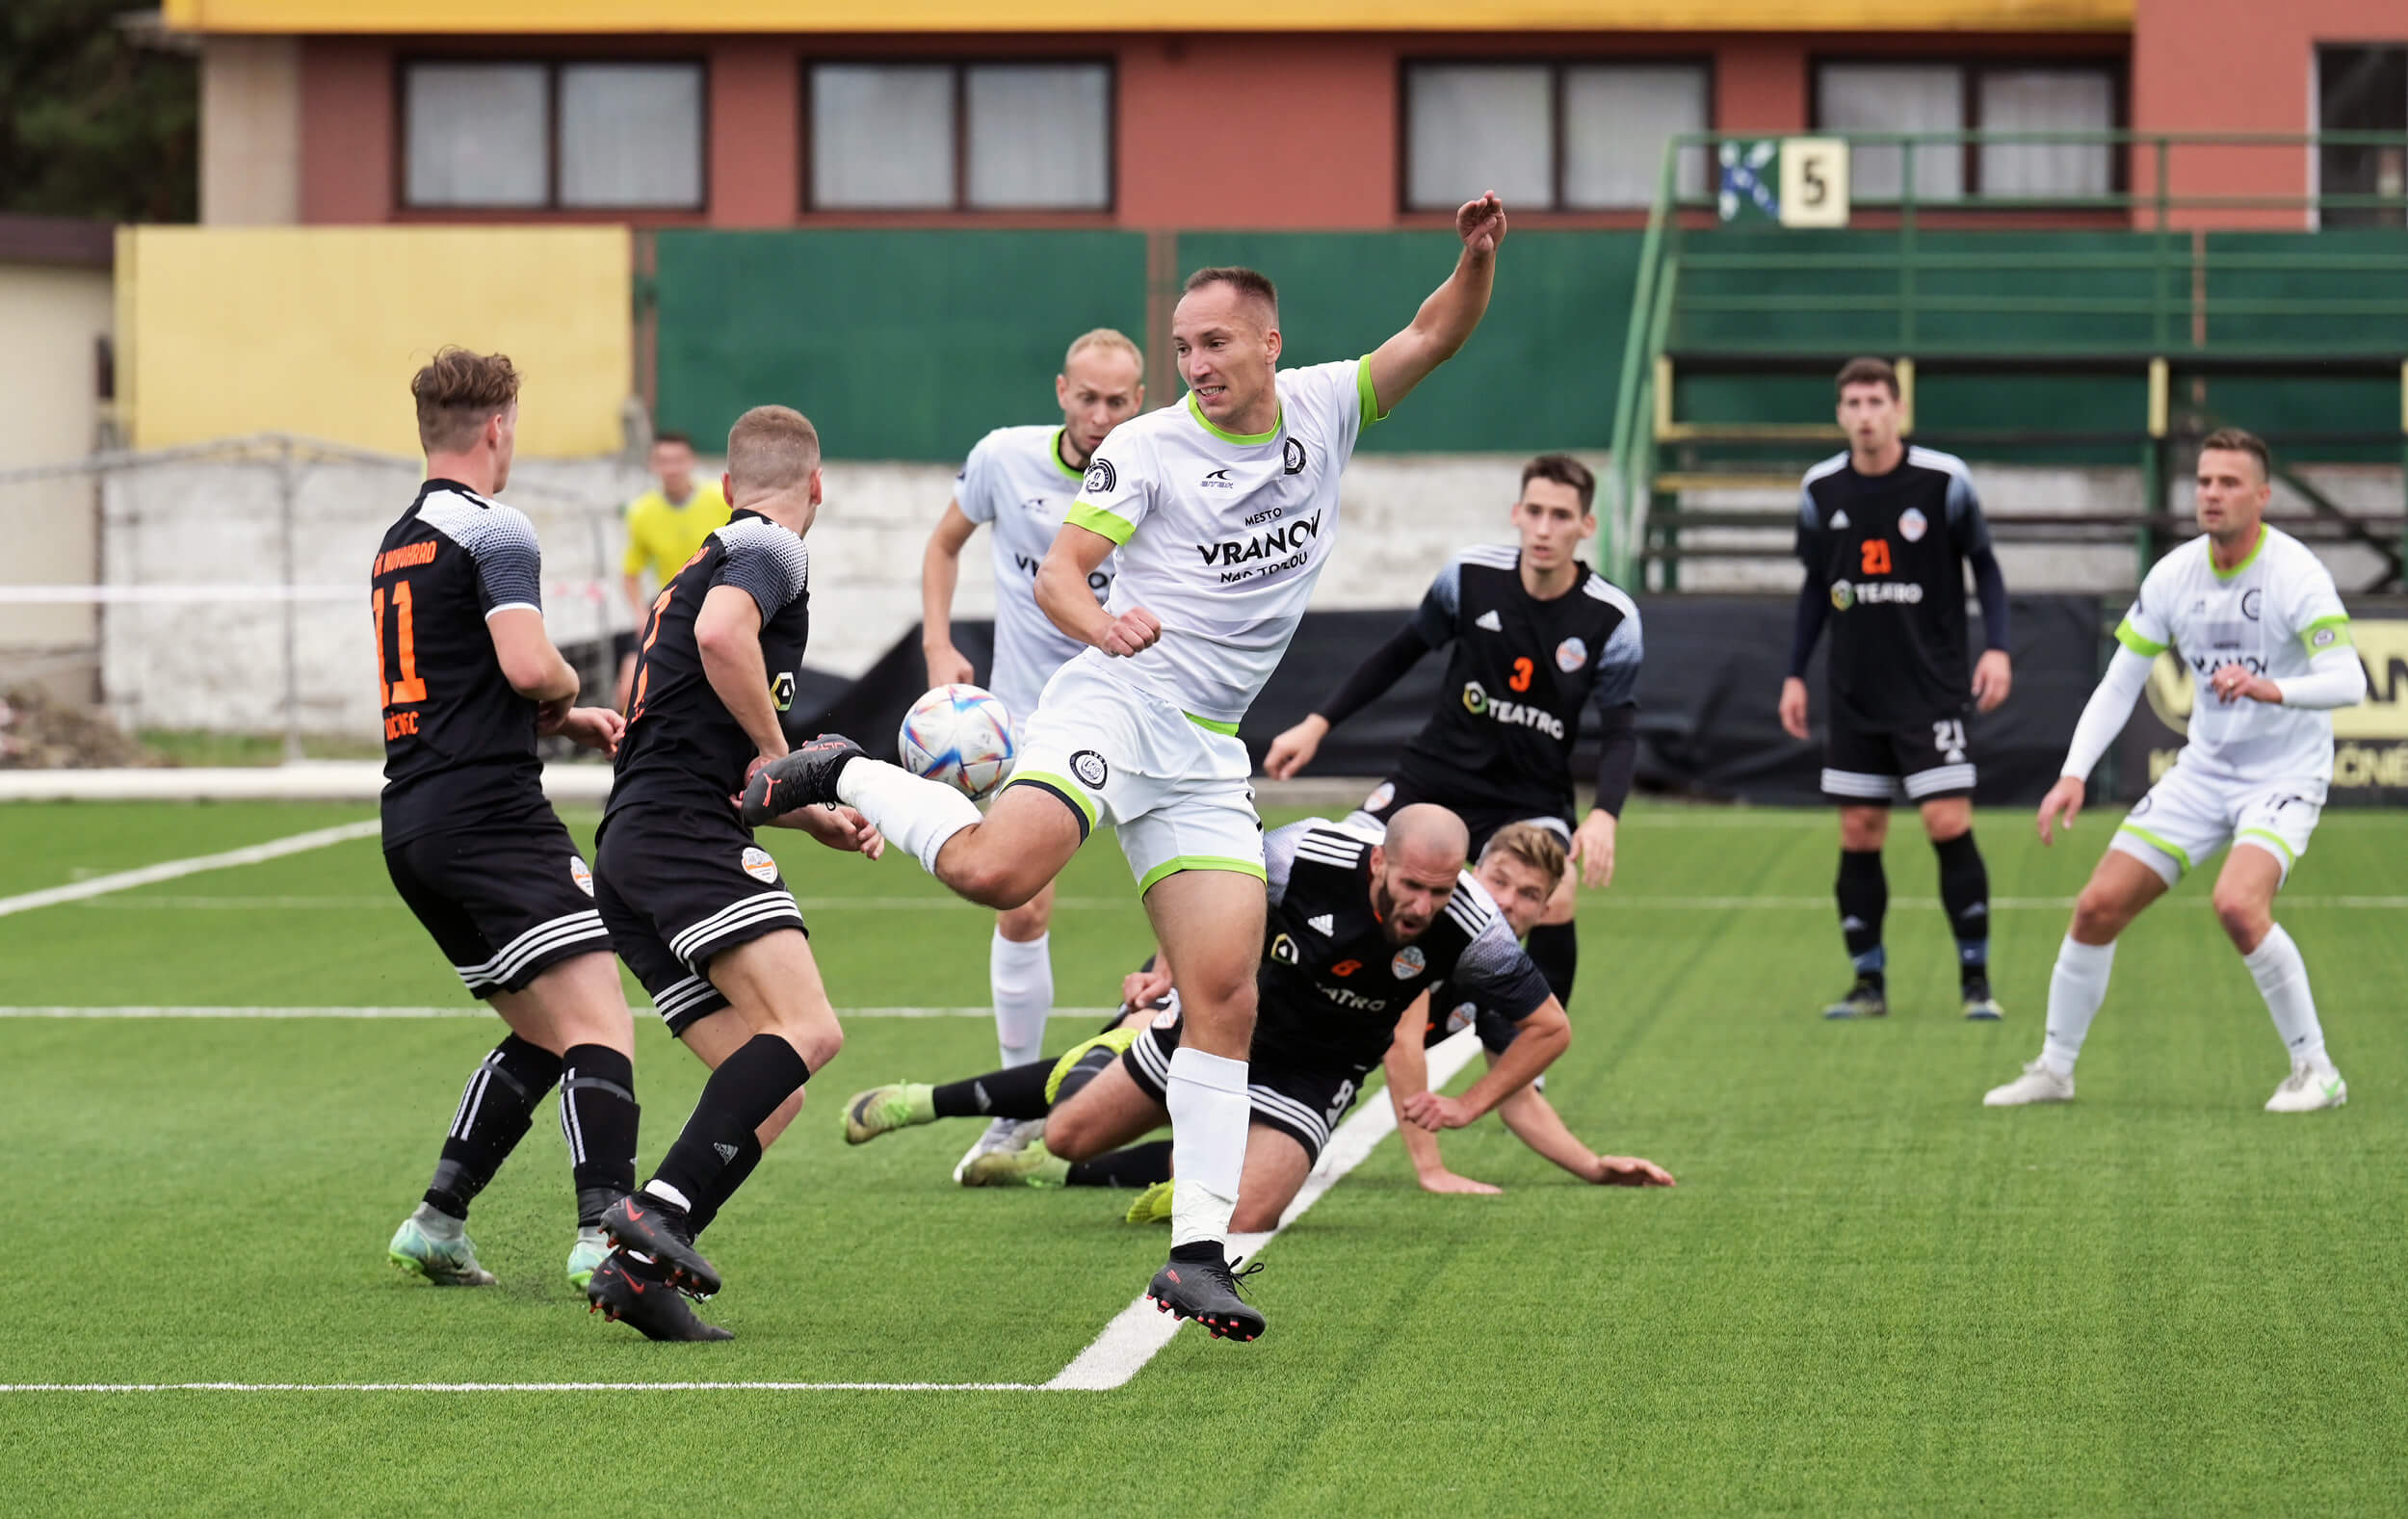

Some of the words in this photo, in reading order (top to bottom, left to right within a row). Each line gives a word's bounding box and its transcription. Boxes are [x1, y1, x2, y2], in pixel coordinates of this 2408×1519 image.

[1805, 157, 1826, 205] 5
[1245, 508, 1282, 527] MESTO
[1197, 509, 1322, 566] VRANOV
[1861, 538, 1893, 575] 21
[1855, 583, 1924, 604] TEATRO
[373, 580, 428, 710] 11
[1509, 656, 1534, 692] 3
[1487, 696, 1565, 741] TEATRO
[1932, 720, 1967, 751] 21
